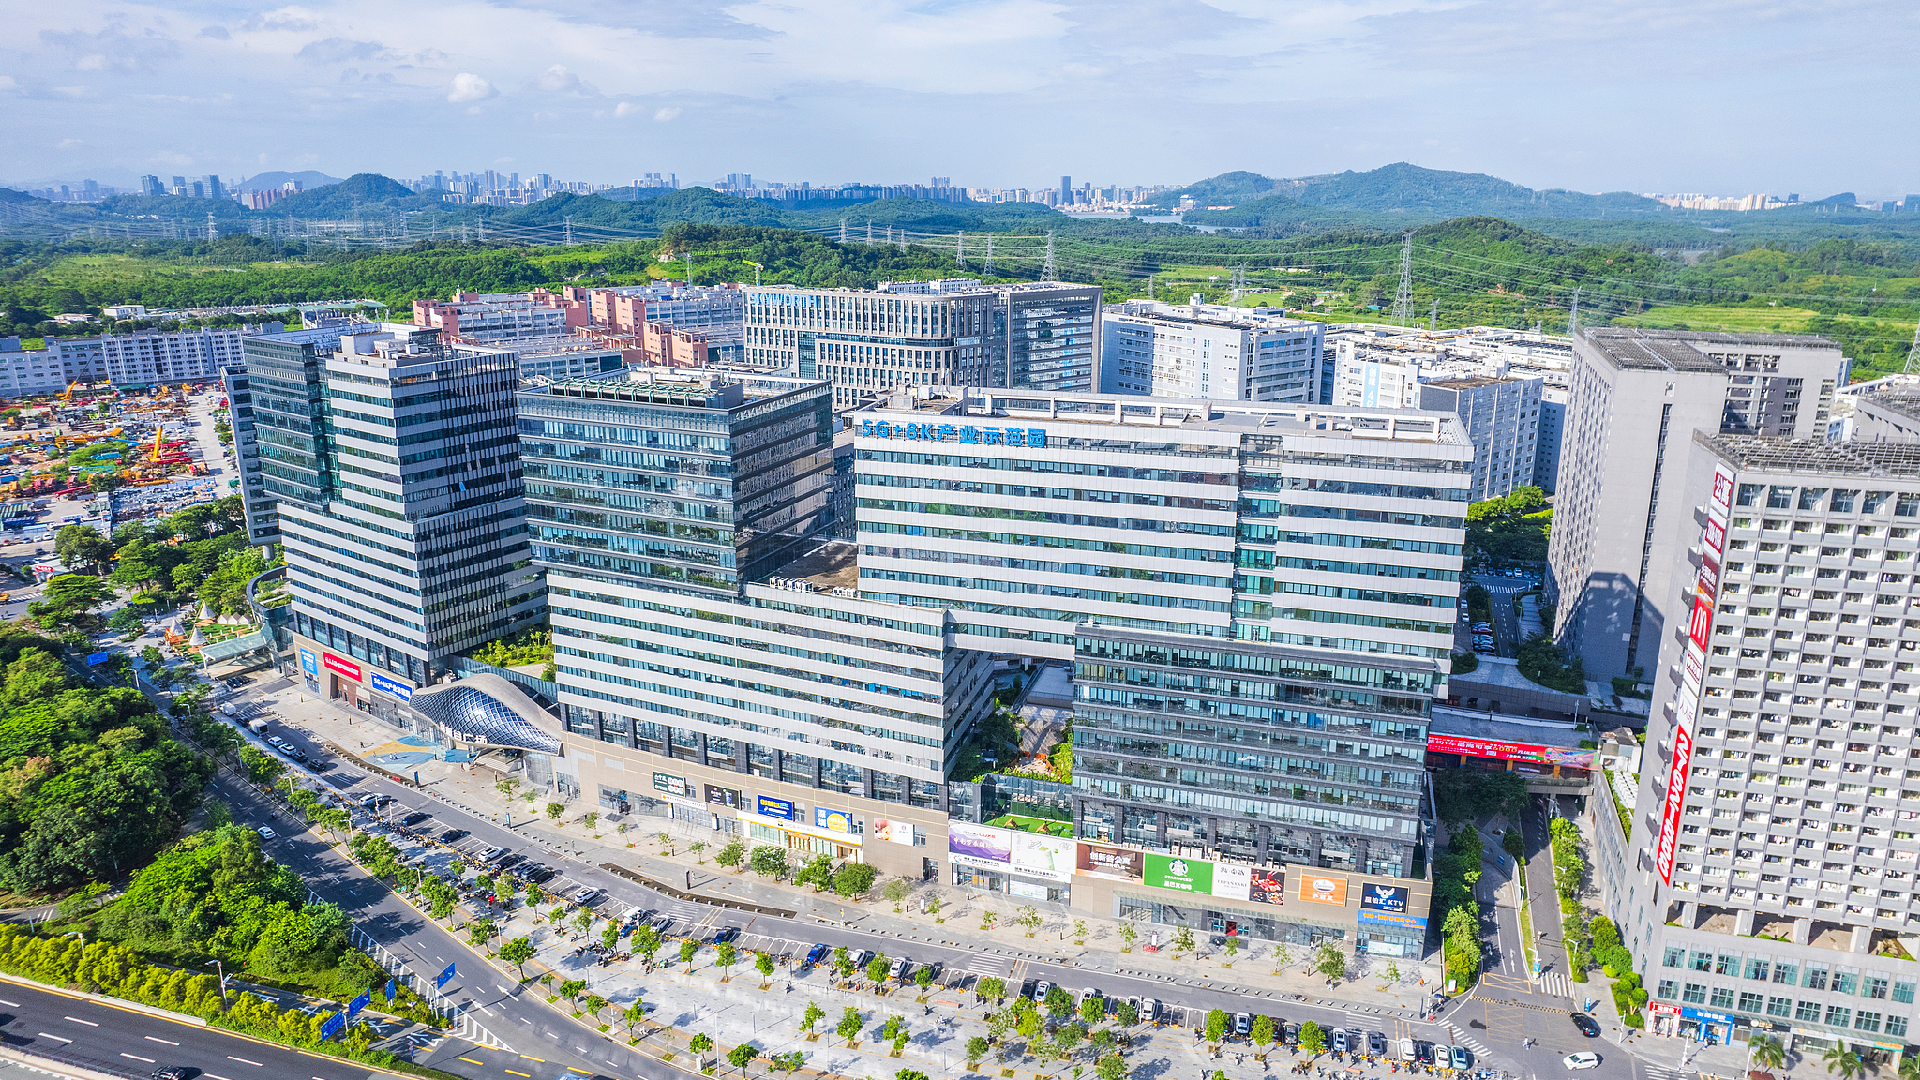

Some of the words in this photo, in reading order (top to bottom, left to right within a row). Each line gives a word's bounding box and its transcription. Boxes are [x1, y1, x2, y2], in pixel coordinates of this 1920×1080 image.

[750, 292, 818, 308] SKYWORTH
[862, 419, 1045, 448] 5G+8K产业示范园
[1657, 732, 1690, 879] 27621888
[1163, 880, 1193, 891] 星巴克咖啡
[1388, 897, 1404, 907] KTV
